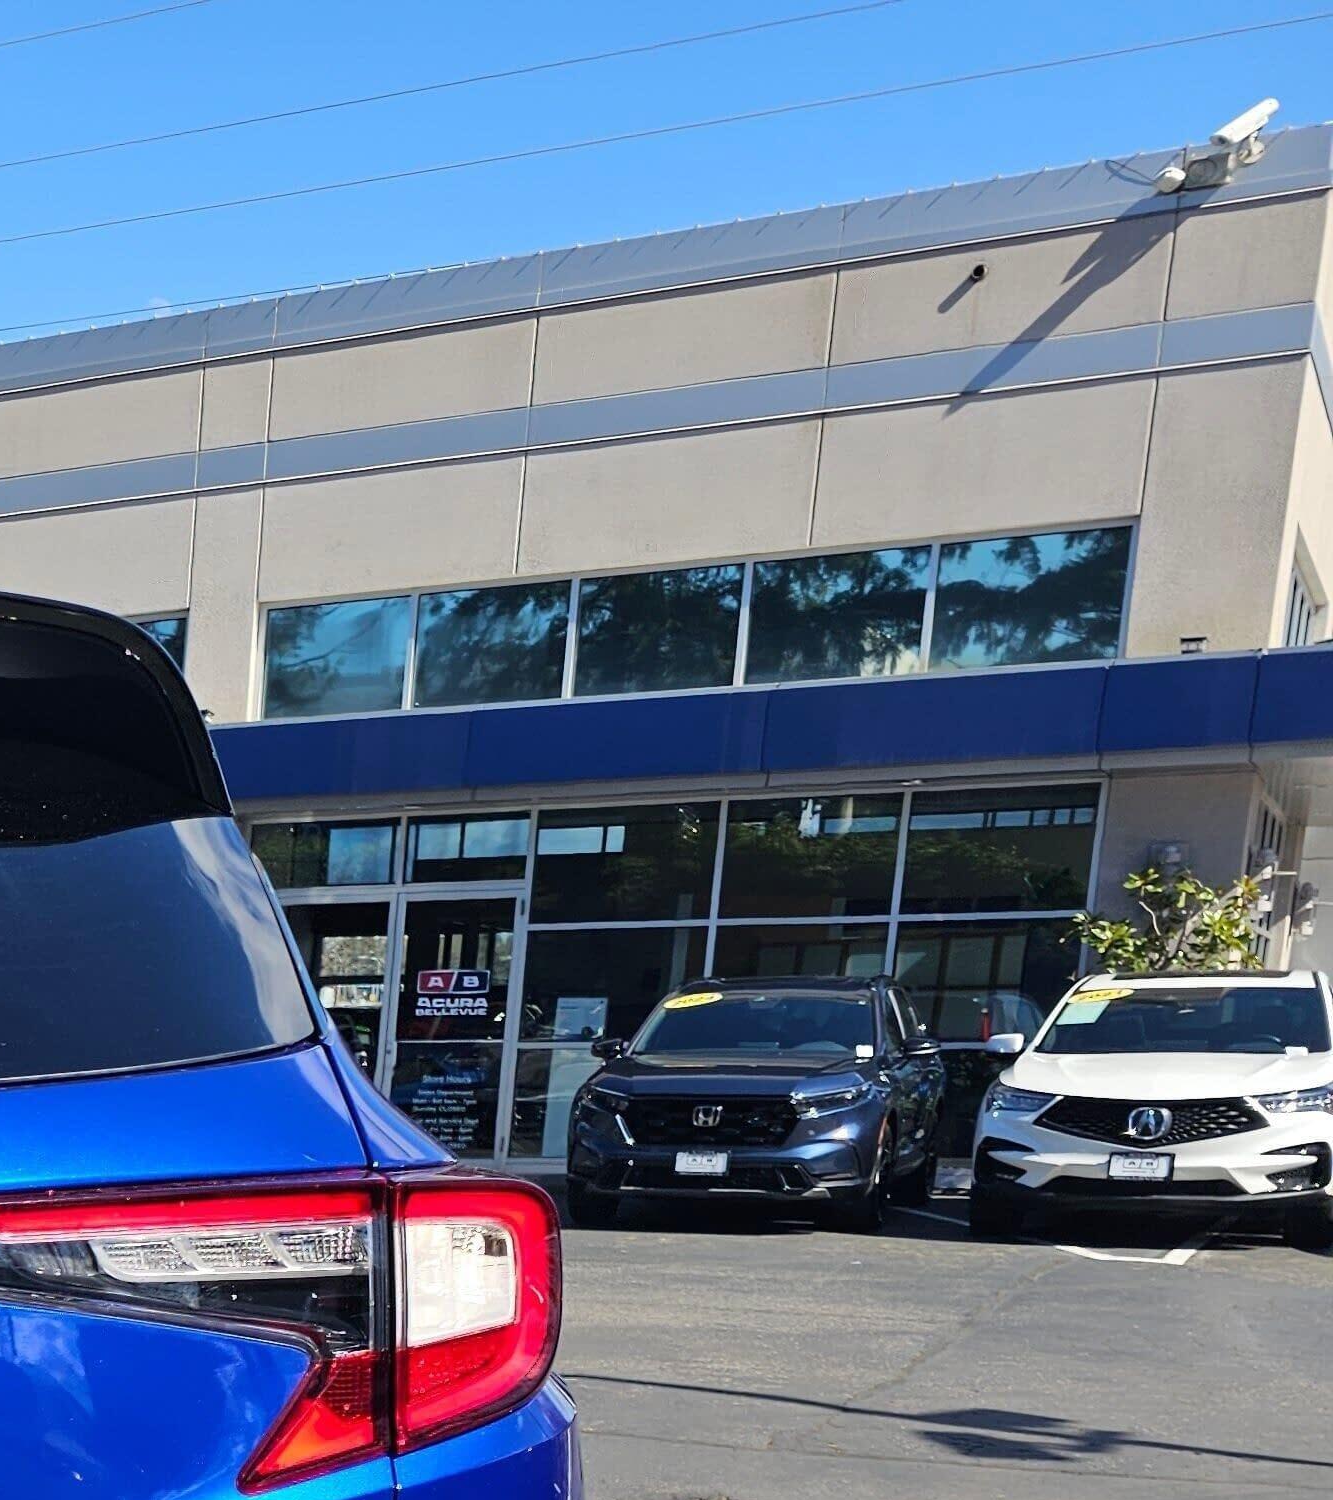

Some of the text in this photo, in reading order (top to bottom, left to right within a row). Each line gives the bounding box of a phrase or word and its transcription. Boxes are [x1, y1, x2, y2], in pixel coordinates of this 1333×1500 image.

[427, 976, 480, 988] A B
[417, 997, 489, 1008] ACURA
[415, 1008, 487, 1017] BELLEVUE
